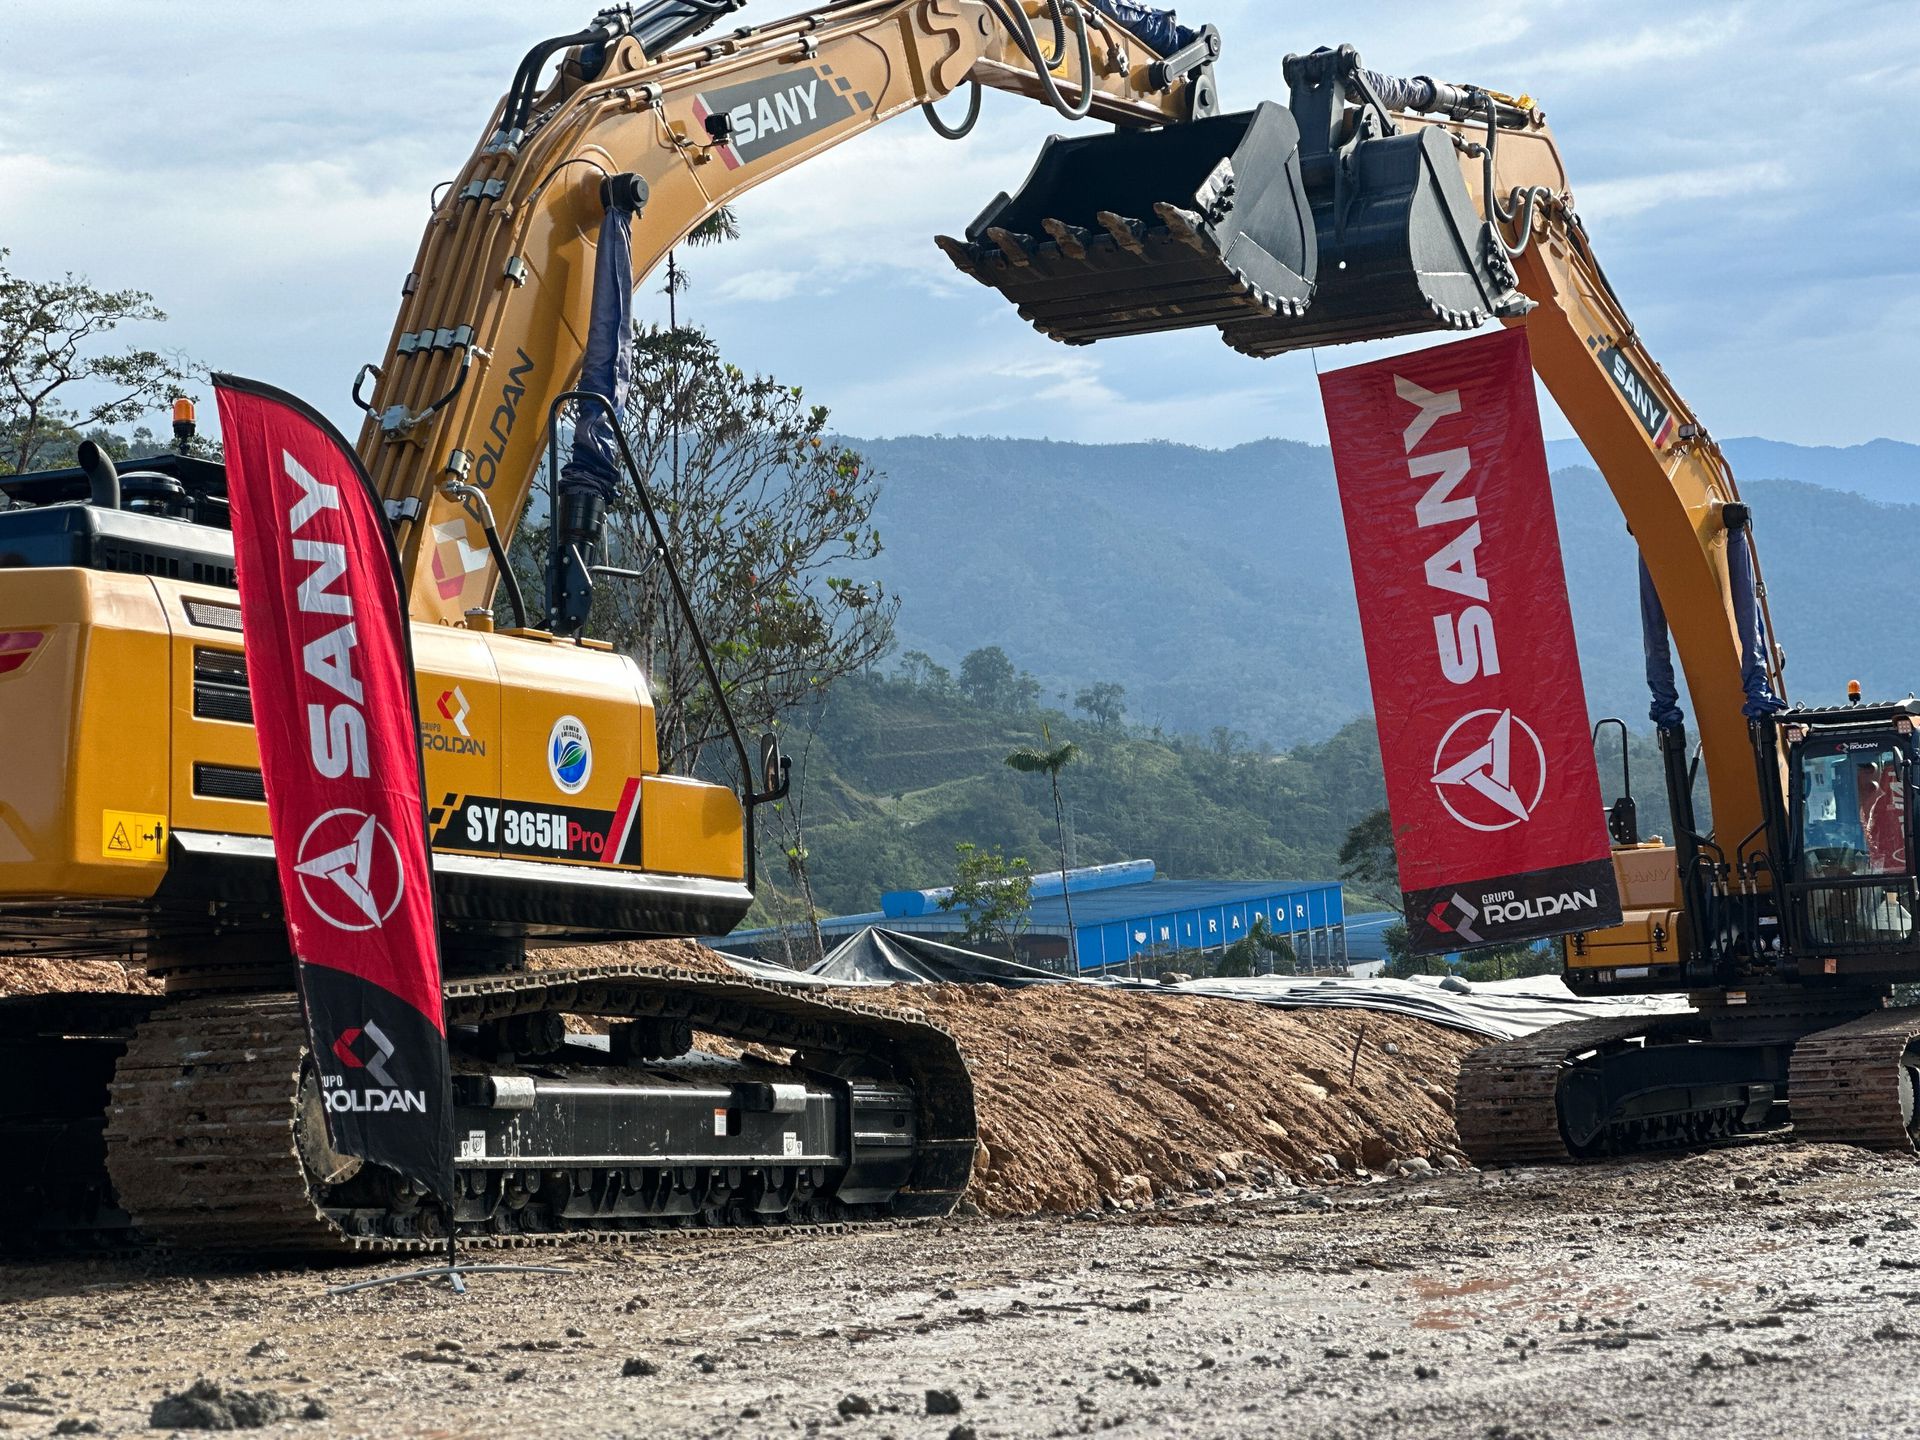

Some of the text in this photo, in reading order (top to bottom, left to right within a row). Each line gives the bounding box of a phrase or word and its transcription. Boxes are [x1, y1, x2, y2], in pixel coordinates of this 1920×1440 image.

[730, 79, 818, 147] SANY
[1613, 353, 1661, 430] SANY
[1393, 373, 1501, 685] SANY
[282, 447, 371, 780] SANY
[420, 732, 486, 757] ROLDAN
[1850, 742, 1878, 750] ROLDAN
[466, 805, 499, 843] SY
[1481, 890, 1515, 904] GRUPO
[1483, 888, 1598, 925] ROLDAN
[1160, 904, 1305, 941] MIRADOR
[321, 1075, 343, 1088] UPO
